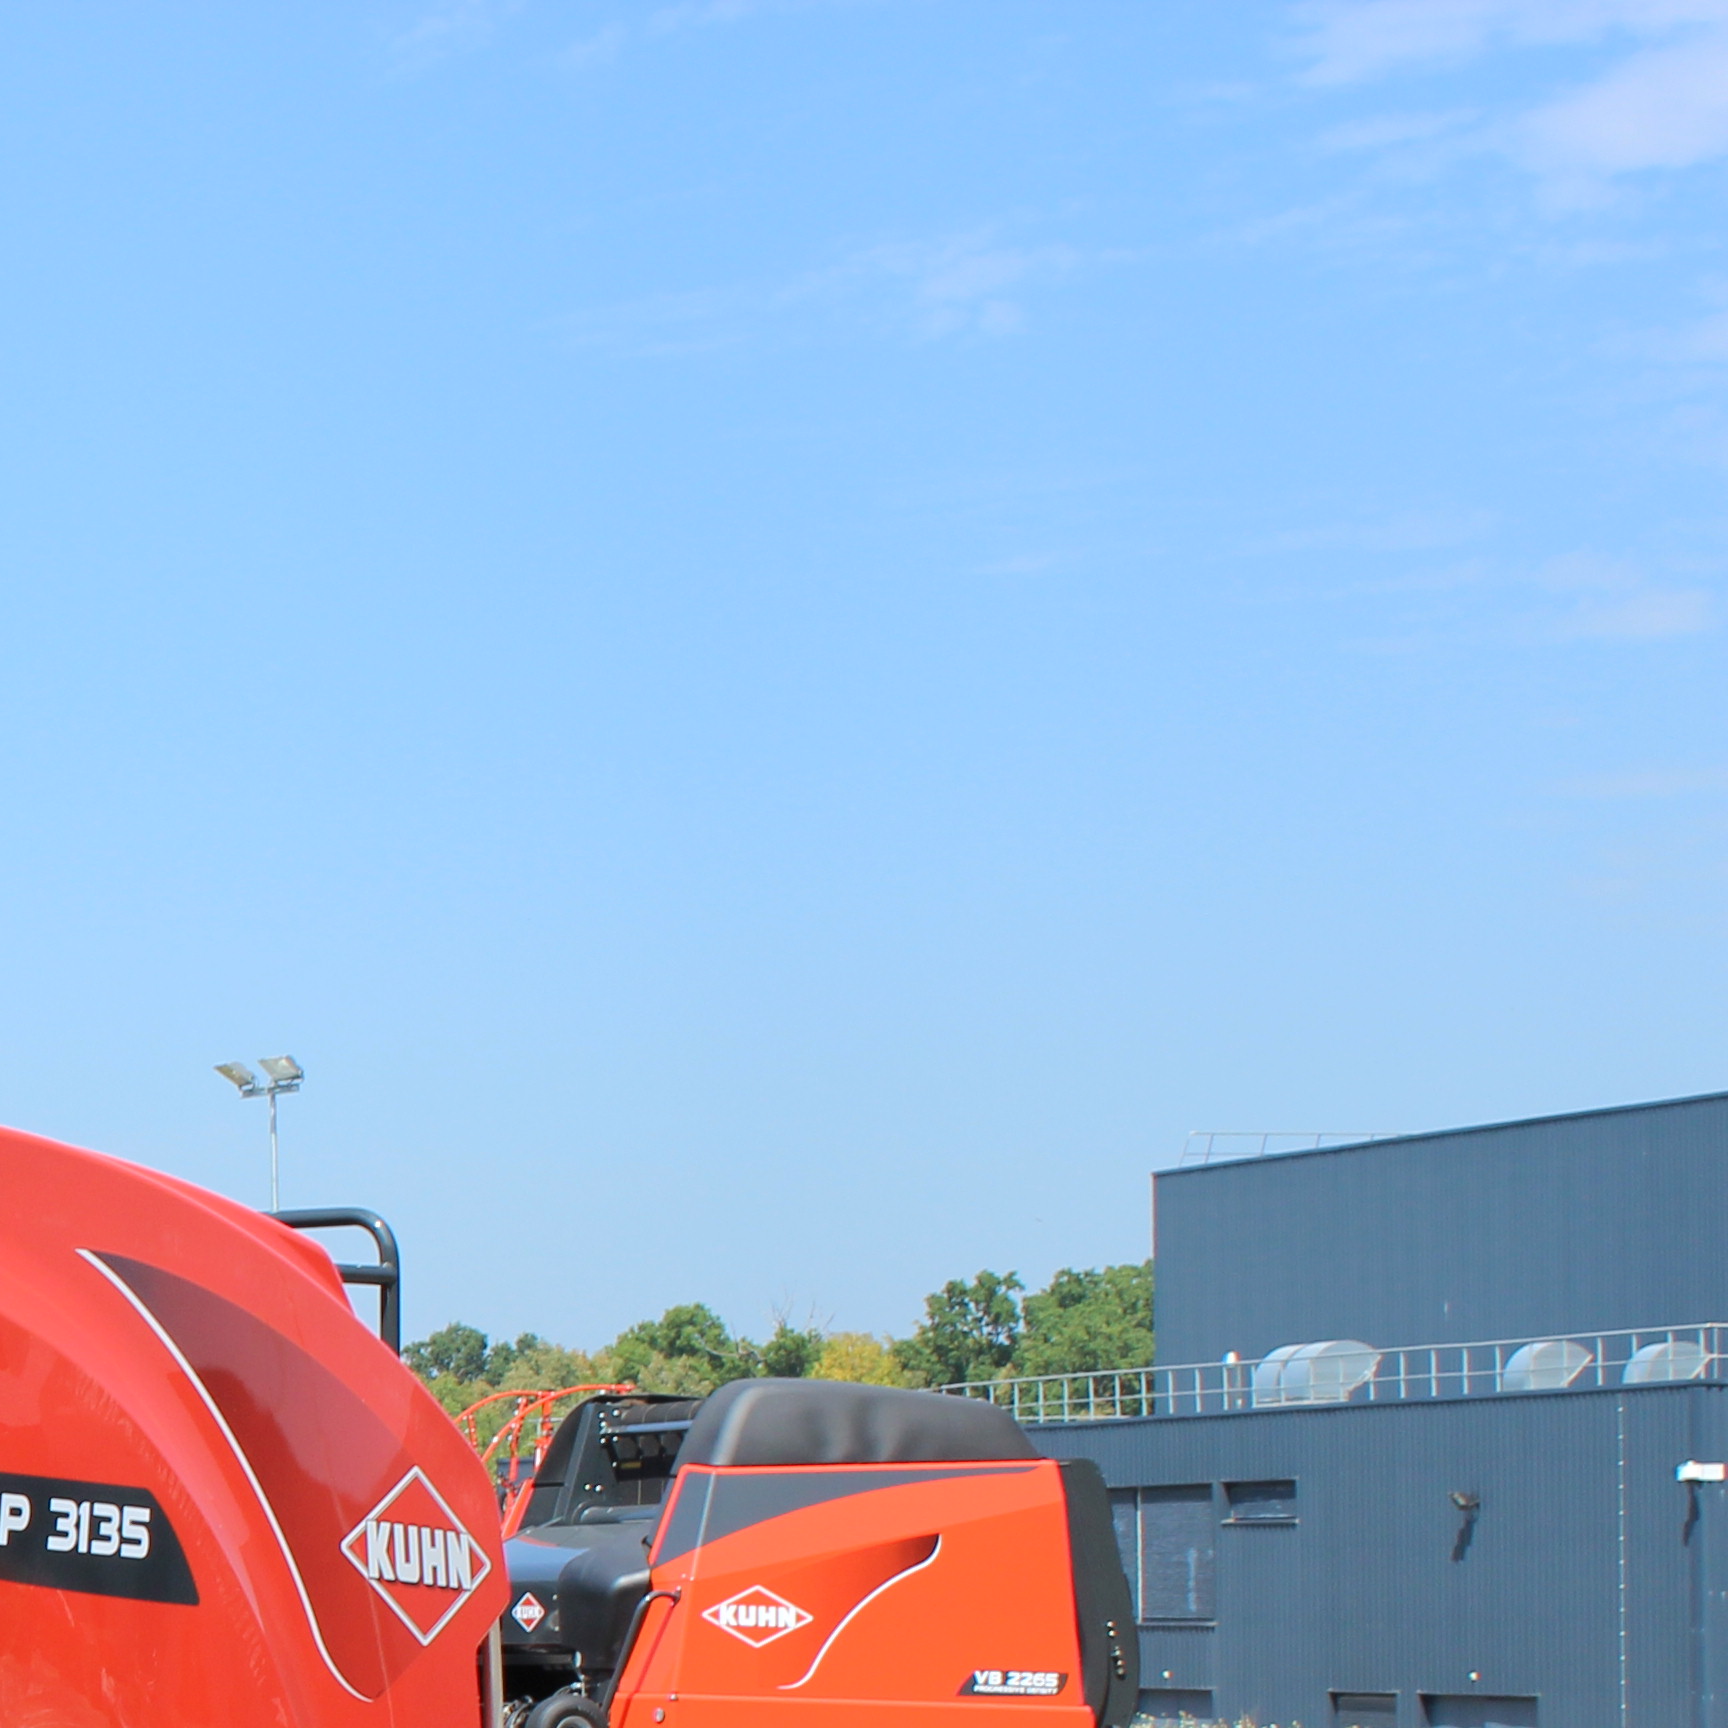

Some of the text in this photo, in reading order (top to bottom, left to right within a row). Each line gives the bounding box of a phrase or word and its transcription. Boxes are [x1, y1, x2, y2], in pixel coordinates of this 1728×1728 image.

[46, 1497, 152, 1560] 3135
[365, 1519, 472, 1591] KUHN
[719, 1604, 798, 1629] KUHN
[973, 1670, 1060, 1688] VB 2265
